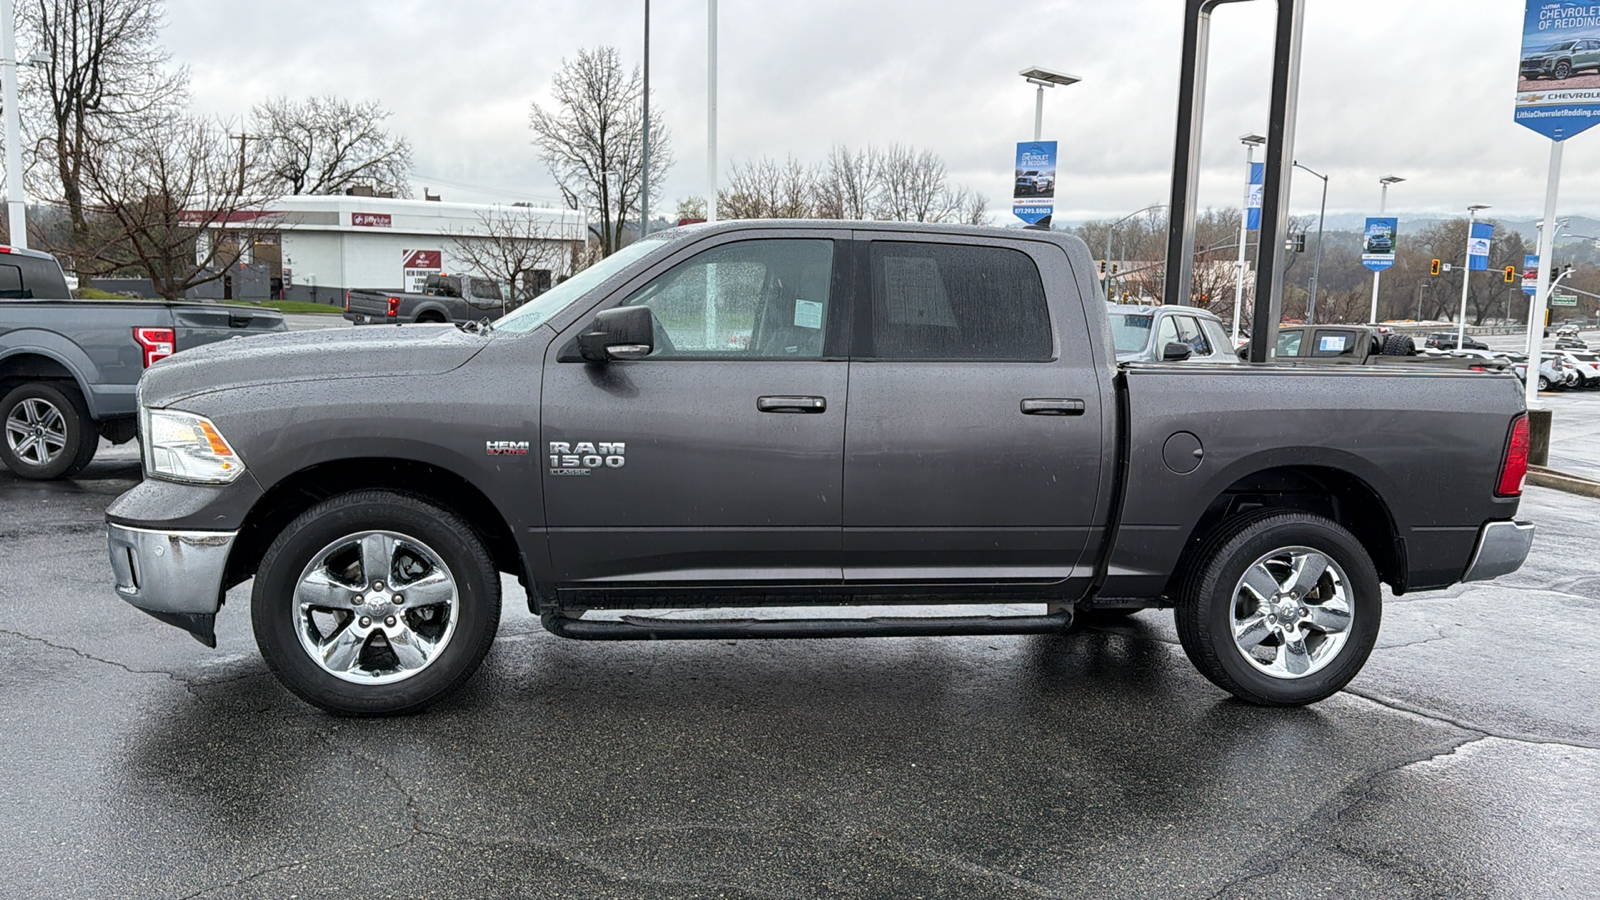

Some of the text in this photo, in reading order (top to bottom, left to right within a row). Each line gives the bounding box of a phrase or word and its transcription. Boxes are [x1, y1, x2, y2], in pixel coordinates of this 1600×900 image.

[1538, 16, 1600, 31] OF REDDING
[1547, 92, 1600, 100] CHEVROLE
[1516, 107, 1600, 119] LithiaChevroletRedding.co
[486, 440, 530, 449] HEMI
[549, 441, 626, 454] RAM
[549, 454, 626, 469] 1500
